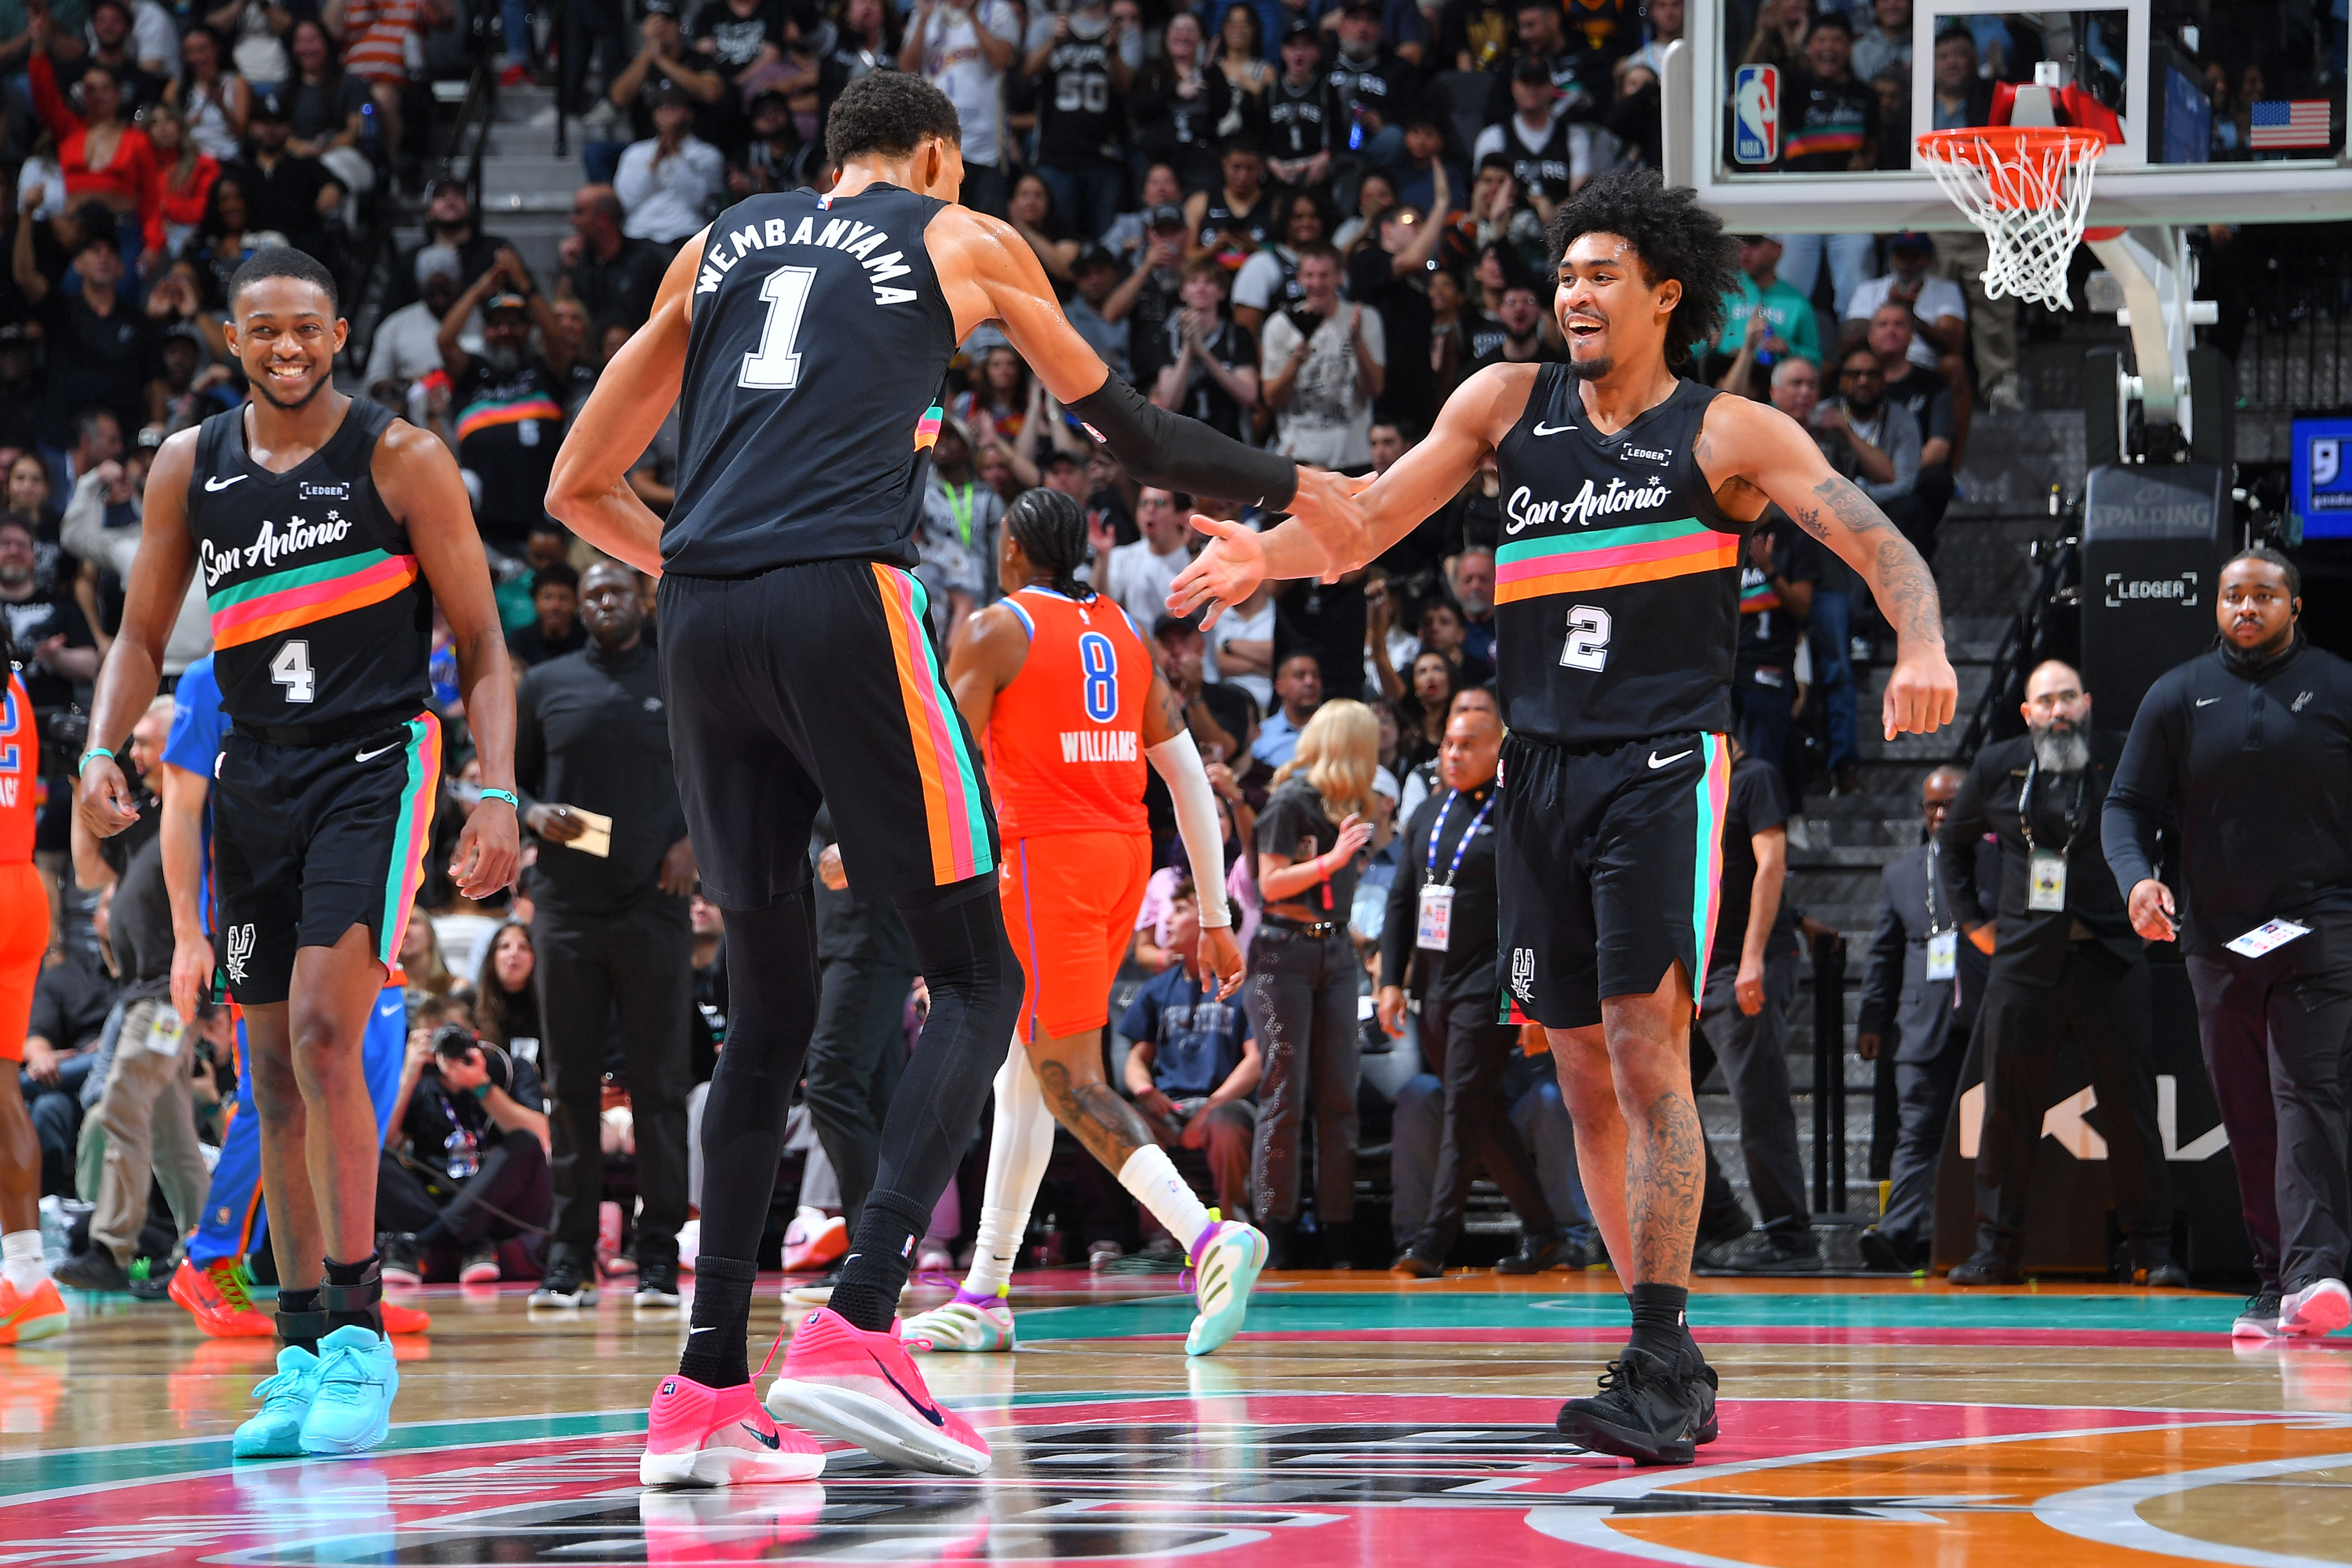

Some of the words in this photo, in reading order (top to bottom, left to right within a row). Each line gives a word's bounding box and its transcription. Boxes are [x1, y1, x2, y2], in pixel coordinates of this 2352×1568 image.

[1290, 125, 1303, 150] 1
[1740, 140, 1760, 157] NBA
[696, 216, 918, 305] WEMBANYAMA
[737, 265, 818, 389] 1
[1627, 448, 1665, 461] LEDGER
[305, 486, 343, 495] LEDGER
[1506, 486, 1558, 535] San
[1561, 476, 1672, 526] Antonio
[2090, 502, 2210, 529] SPALDING
[201, 539, 240, 587] San
[244, 510, 352, 567] Antonio
[2118, 580, 2185, 599] LEDGER
[1559, 604, 1612, 673] 2
[269, 639, 315, 703] 4
[1079, 631, 1118, 723] 8
[1060, 730, 1137, 763] WILLIAMS
